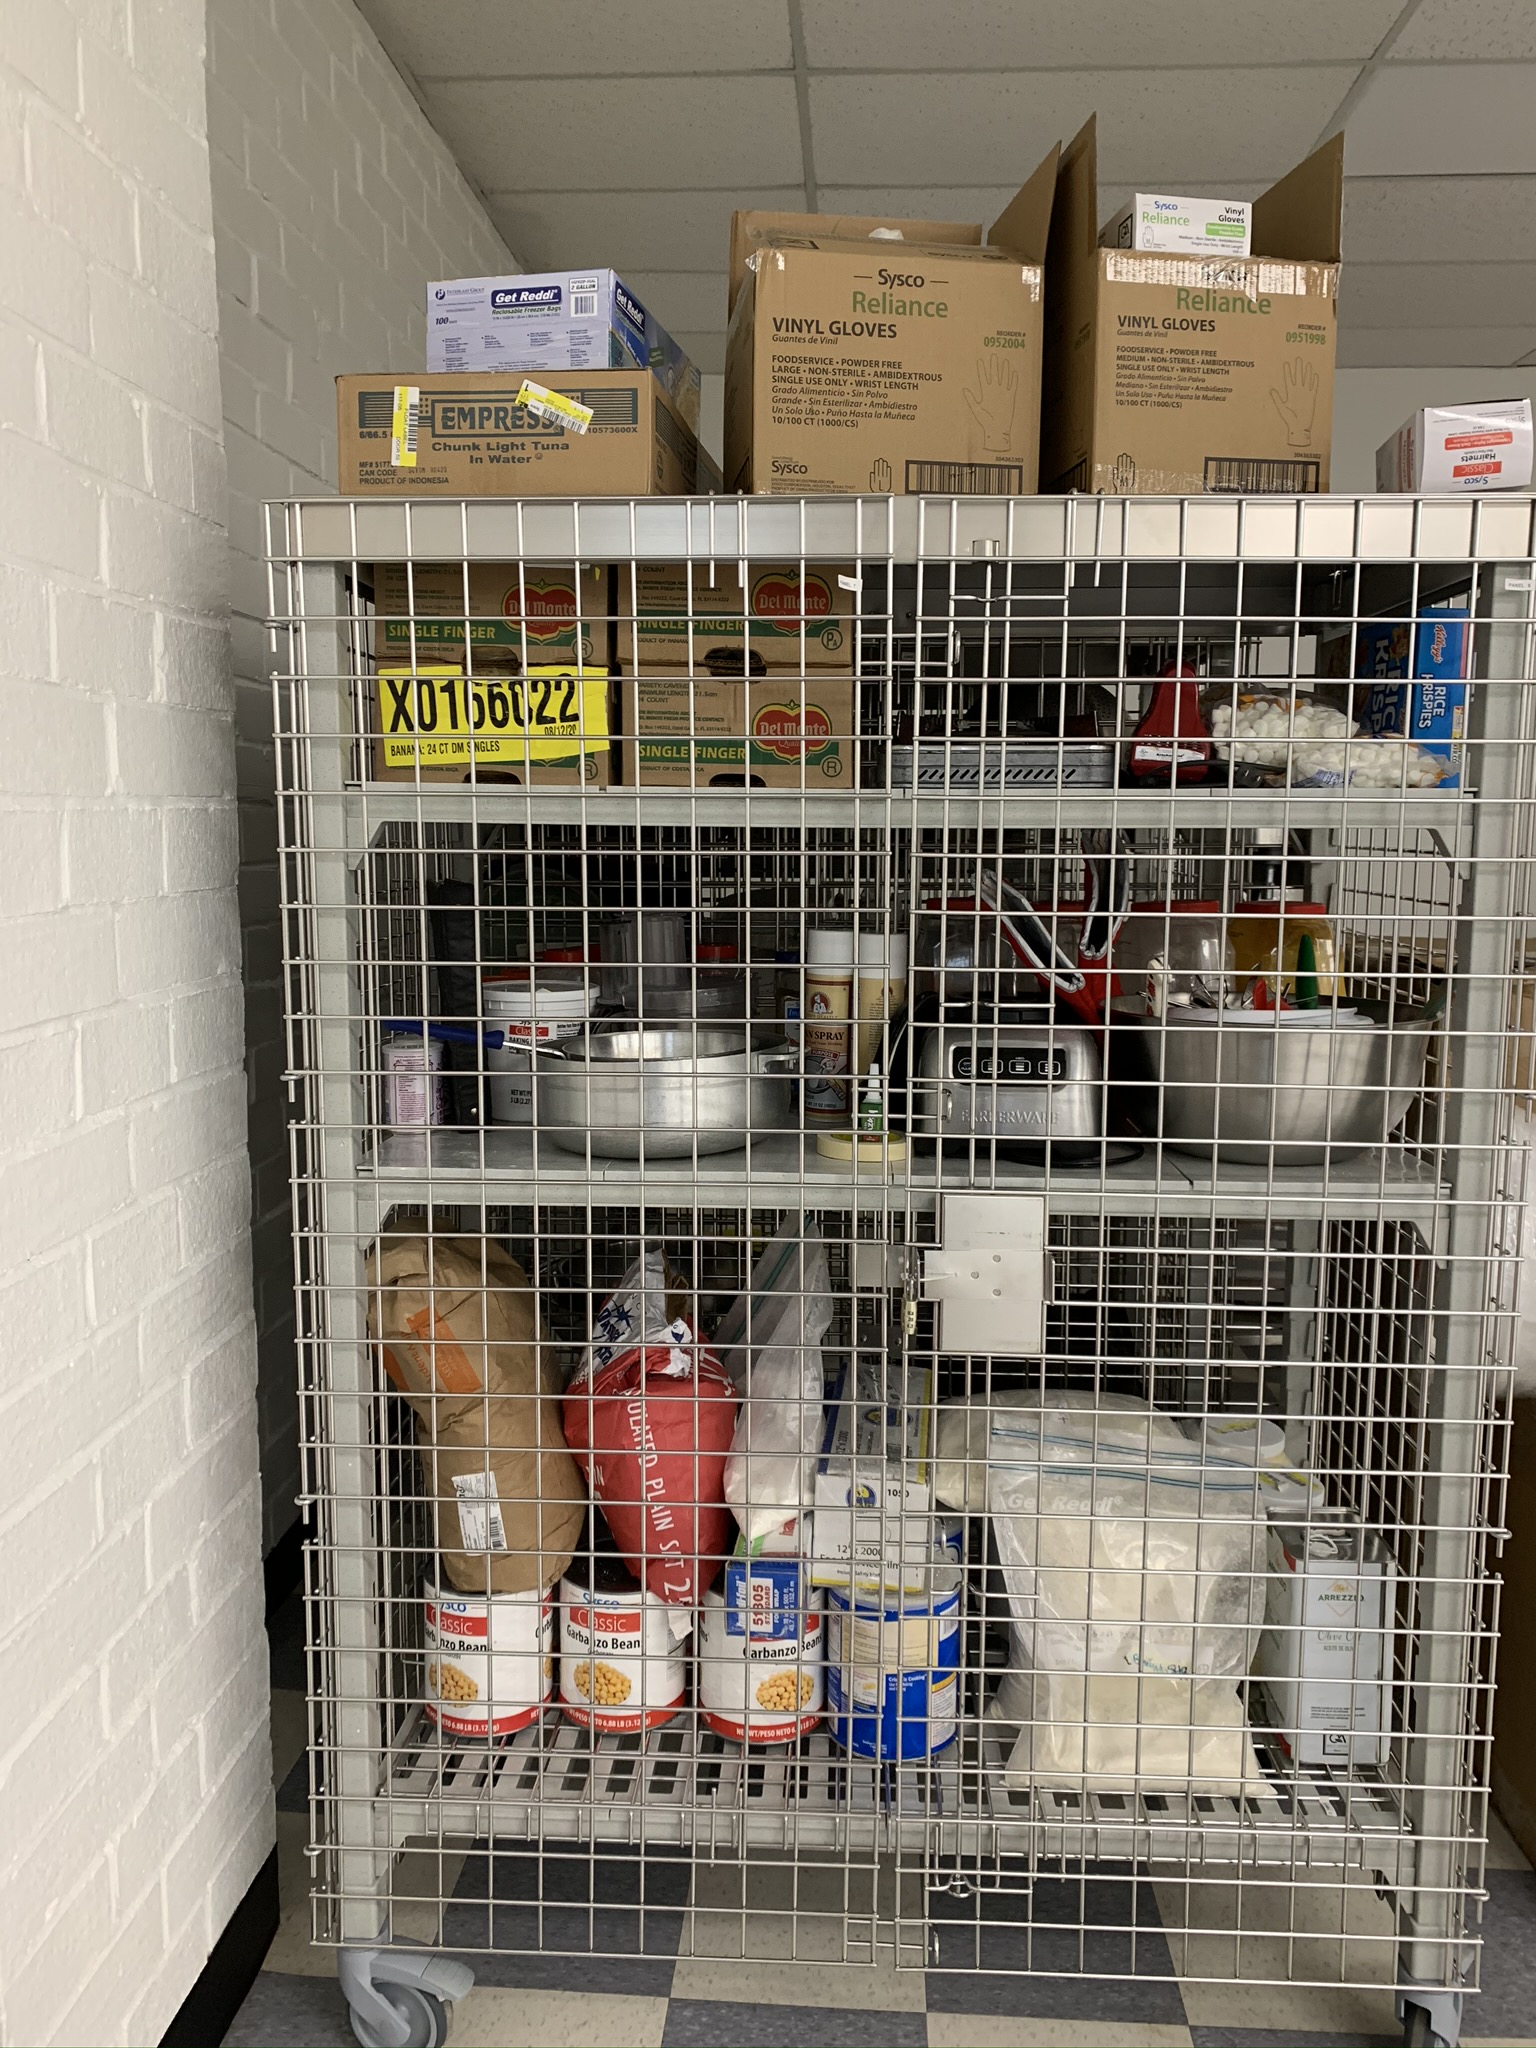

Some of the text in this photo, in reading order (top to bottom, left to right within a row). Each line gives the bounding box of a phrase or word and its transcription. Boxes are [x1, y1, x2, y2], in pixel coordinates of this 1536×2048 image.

[1154, 201, 1178, 211] Sysco
[1224, 207, 1245, 216] Vinyl
[1142, 212, 1190, 226] Reliance
[1218, 215, 1245, 224] Gloves
[878, 268, 925, 290] Sysco
[495, 292, 516, 304] Get
[616, 288, 628, 307] Get
[852, 290, 948, 318] Reliance
[1176, 288, 1272, 314] Reliance
[524, 306, 546, 314] Freezer
[547, 304, 562, 312] Bags
[435, 317, 449, 325] 100
[772, 317, 897, 338] VINYL GLOVES
[1118, 314, 1216, 332] VINYL GLOVES
[772, 334, 838, 345] Guantes de Vinil
[1116, 329, 1144, 337] Guantes
[1144, 330, 1152, 338] de
[1286, 332, 1326, 345] 0951998
[983, 336, 1026, 349] 0952004
[1116, 346, 1217, 358] FOODSERVICE POWDER FREE
[772, 355, 903, 370] FOODSERVICE POWDER FREE
[1116, 354, 1255, 368] MEDIUM NON-STERILE AMBIDEXTROUS
[772, 366, 943, 382] LARGE NON-STERILE AMBIDEXTROUS
[1142, 364, 1156, 372] USE
[1180, 366, 1201, 374] WRIST
[1202, 368, 1230, 376] LENGTH
[772, 376, 919, 390] SINGLE USE ONLY WRIST LENGTH
[772, 386, 888, 400] Grado Alimenticio Sin Polvo
[772, 396, 918, 411] Grande Sin Esterilizar Ambidiestro
[442, 406, 554, 432] EMPRESS
[772, 406, 784, 414] Un
[784, 406, 803, 415] Solo
[849, 410, 873, 418] Hasta
[874, 411, 882, 419] la
[772, 416, 860, 428] 10/100 CT (1000/CS)
[587, 426, 638, 434] 10573600X
[432, 441, 570, 452] Chunk Light Tuna
[470, 454, 532, 464] In Water
[1460, 452, 1496, 462] Hairnets
[772, 460, 808, 476] Sysco
[1461, 463, 1494, 475] Classic
[1464, 476, 1490, 485] Sysco
[508, 600, 576, 617] Dl Monte
[760, 594, 780, 609] Del
[388, 624, 496, 639] SINGLE FINGER
[636, 620, 744, 631] SINGLE FINGER
[1430, 624, 1447, 664] Kellogg's
[1370, 638, 1390, 733] KRISP
[1382, 668, 1402, 734] RIC
[1418, 674, 1434, 729] KRISPIES
[1432, 686, 1447, 717] RICE
[760, 721, 828, 736] Del Monte
[427, 744, 437, 756] 24
[439, 743, 450, 755] CT
[452, 742, 465, 754] DM
[467, 740, 500, 754] SNGLES
[638, 744, 746, 760] SINGLE FINGER
[826, 760, 837, 774] R
[515, 1026, 542, 1036] Clasc
[814, 1031, 846, 1041] SPRAY
[645, 1478, 675, 1532] PLAIN
[1006, 1494, 1038, 1511] Ge
[659, 1540, 685, 1569] SLT
[430, 1609, 474, 1636] Cassic
[458, 1640, 488, 1653] Bean
[611, 1638, 640, 1650] Bean
[452, 1721, 464, 1732] 6.88
[464, 1723, 472, 1732] LB
[603, 1718, 617, 1728] 6.88
[617, 1719, 624, 1728] LB
[748, 1726, 790, 1739] WT/PESO NETO
